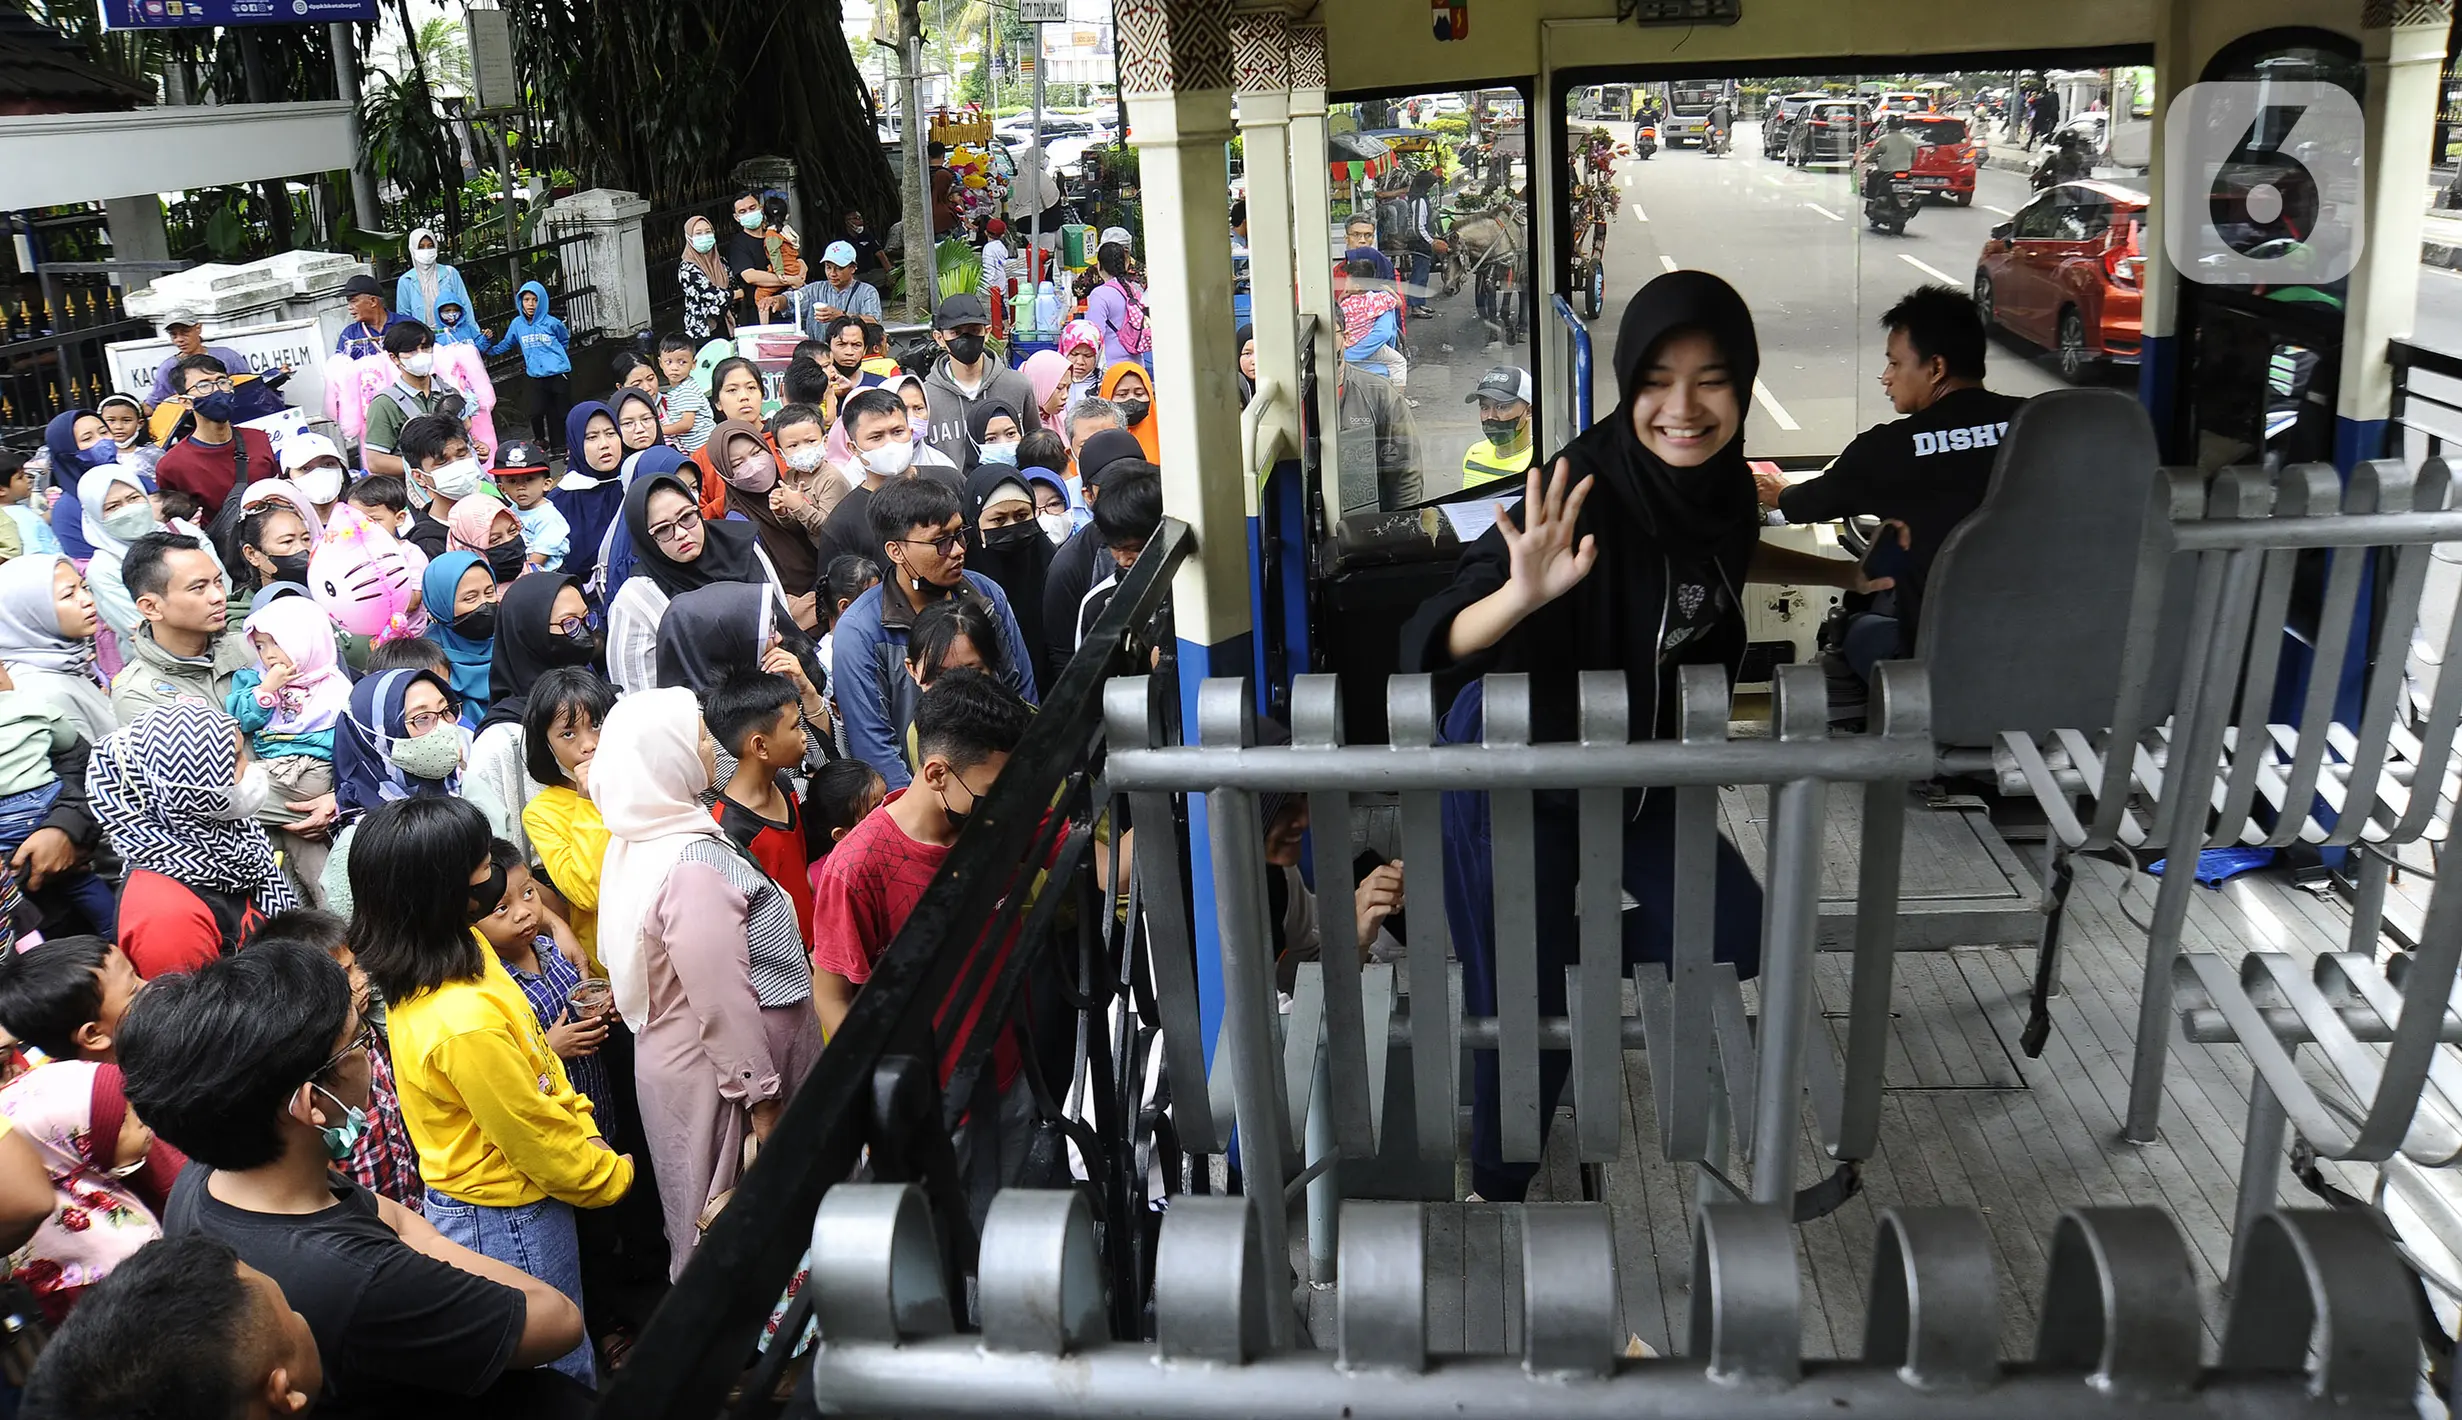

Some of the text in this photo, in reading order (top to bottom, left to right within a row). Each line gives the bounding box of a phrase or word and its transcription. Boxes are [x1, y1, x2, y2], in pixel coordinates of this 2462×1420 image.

[1022, 2, 1033, 17] CITY
[1033, 2, 1047, 17] TOUR
[272, 346, 311, 368] HELM
